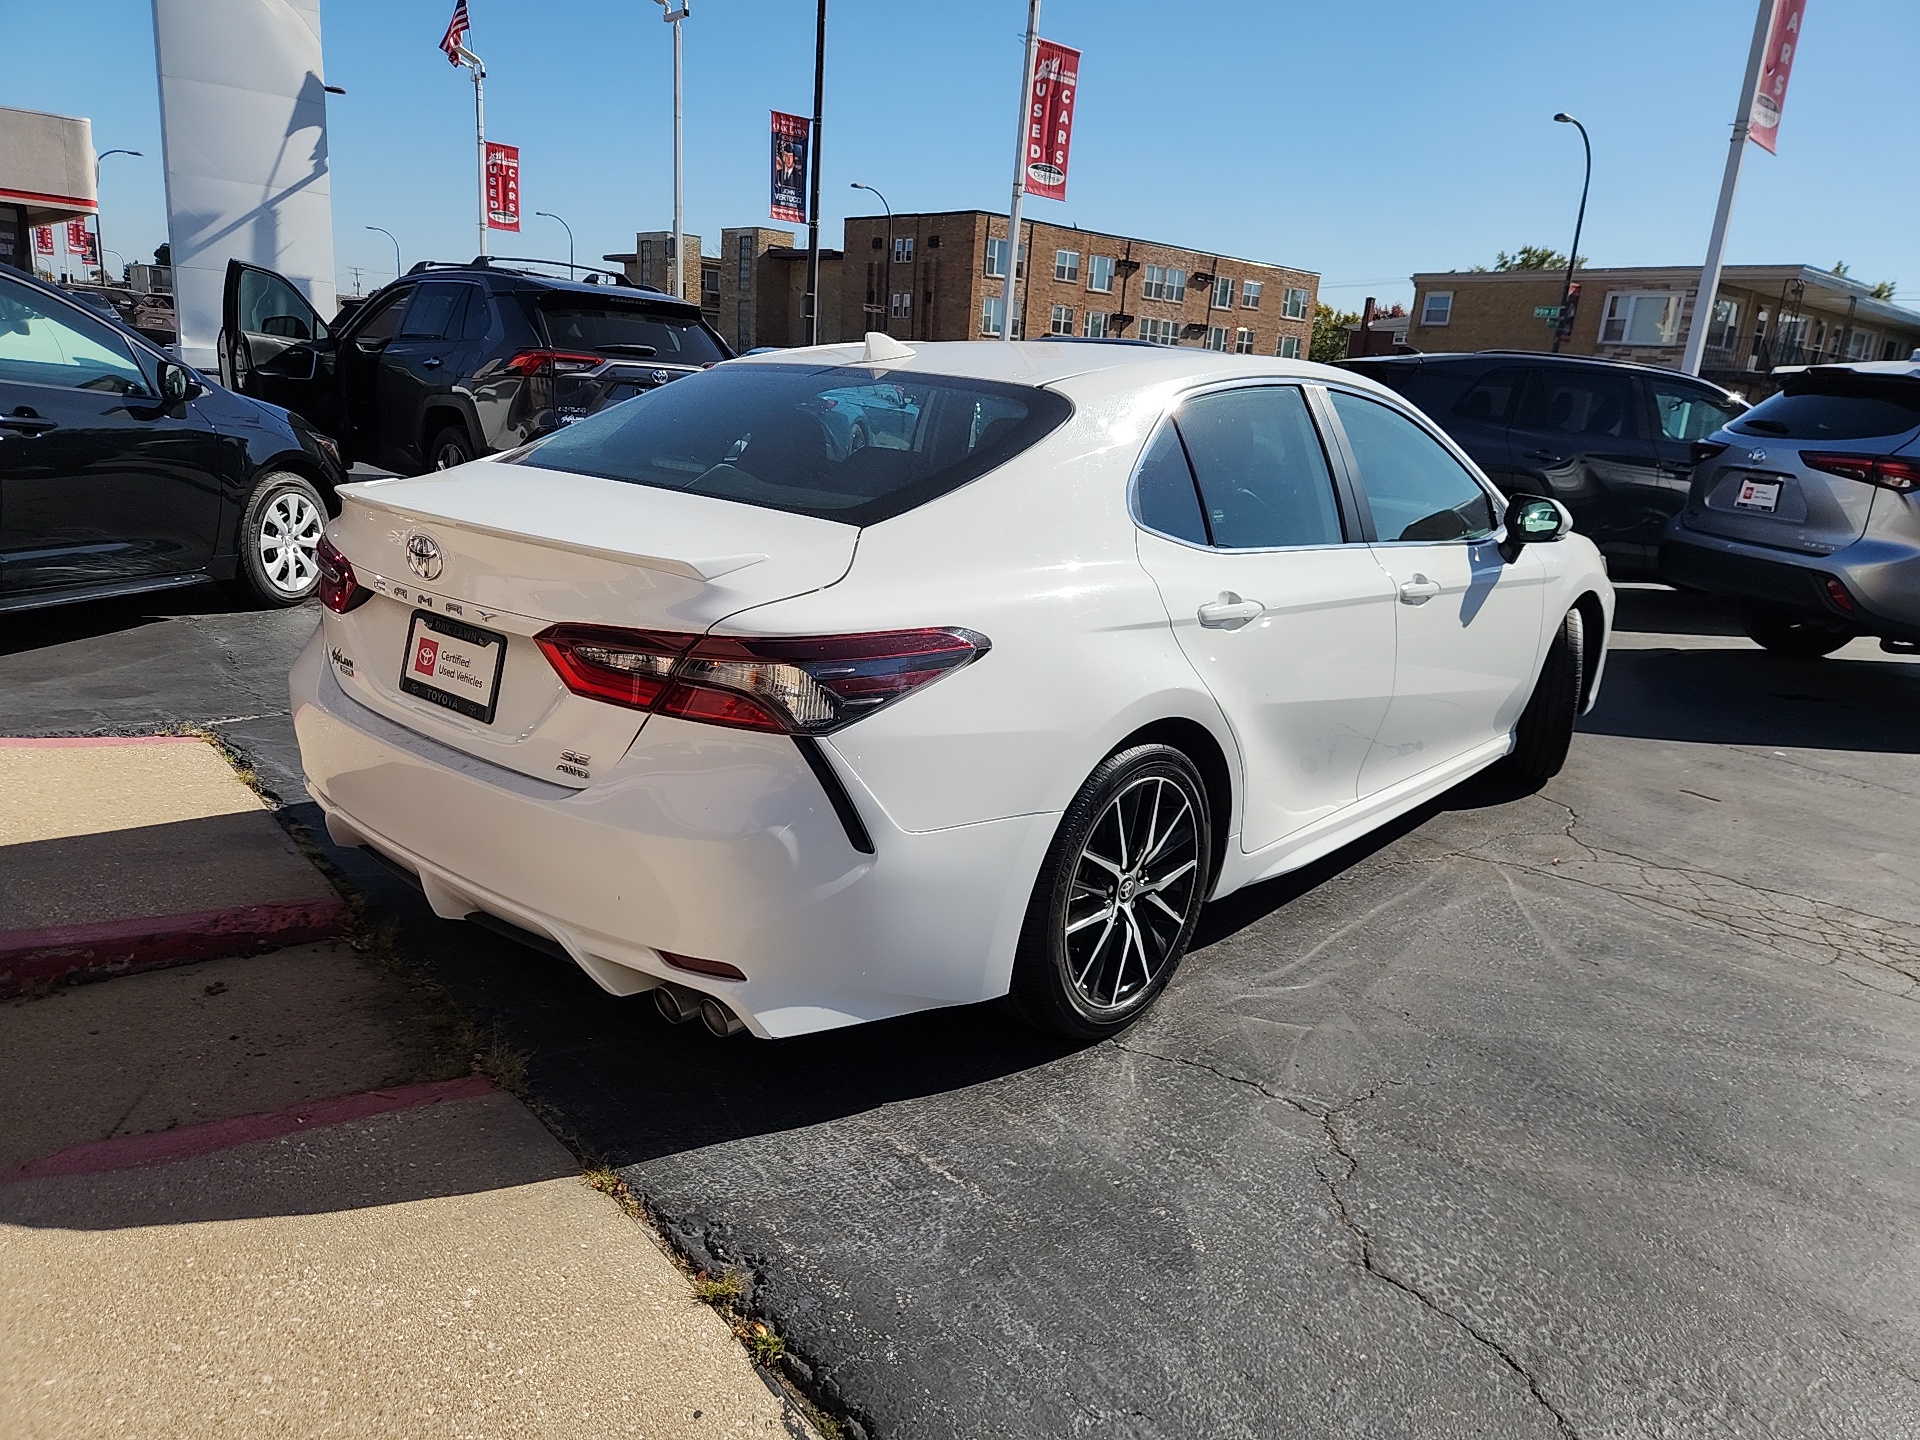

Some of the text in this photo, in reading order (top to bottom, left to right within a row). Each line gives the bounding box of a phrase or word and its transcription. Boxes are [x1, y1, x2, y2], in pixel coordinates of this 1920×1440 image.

[1773, 11, 1798, 96] ARS
[1030, 83, 1047, 158] USED
[1055, 89, 1071, 165] CARS
[489, 165, 499, 209] USED
[508, 168, 517, 212] CARS
[774, 192, 802, 205] VERTUCCI
[782, 188, 796, 196] JOHN
[373, 579, 499, 623] CAMRY
[441, 650, 471, 669] Certified
[438, 663, 483, 689] Used Vehicles
[426, 688, 458, 710] TOYOTA
[560, 748, 591, 766] SE
[556, 762, 590, 779] AWD
